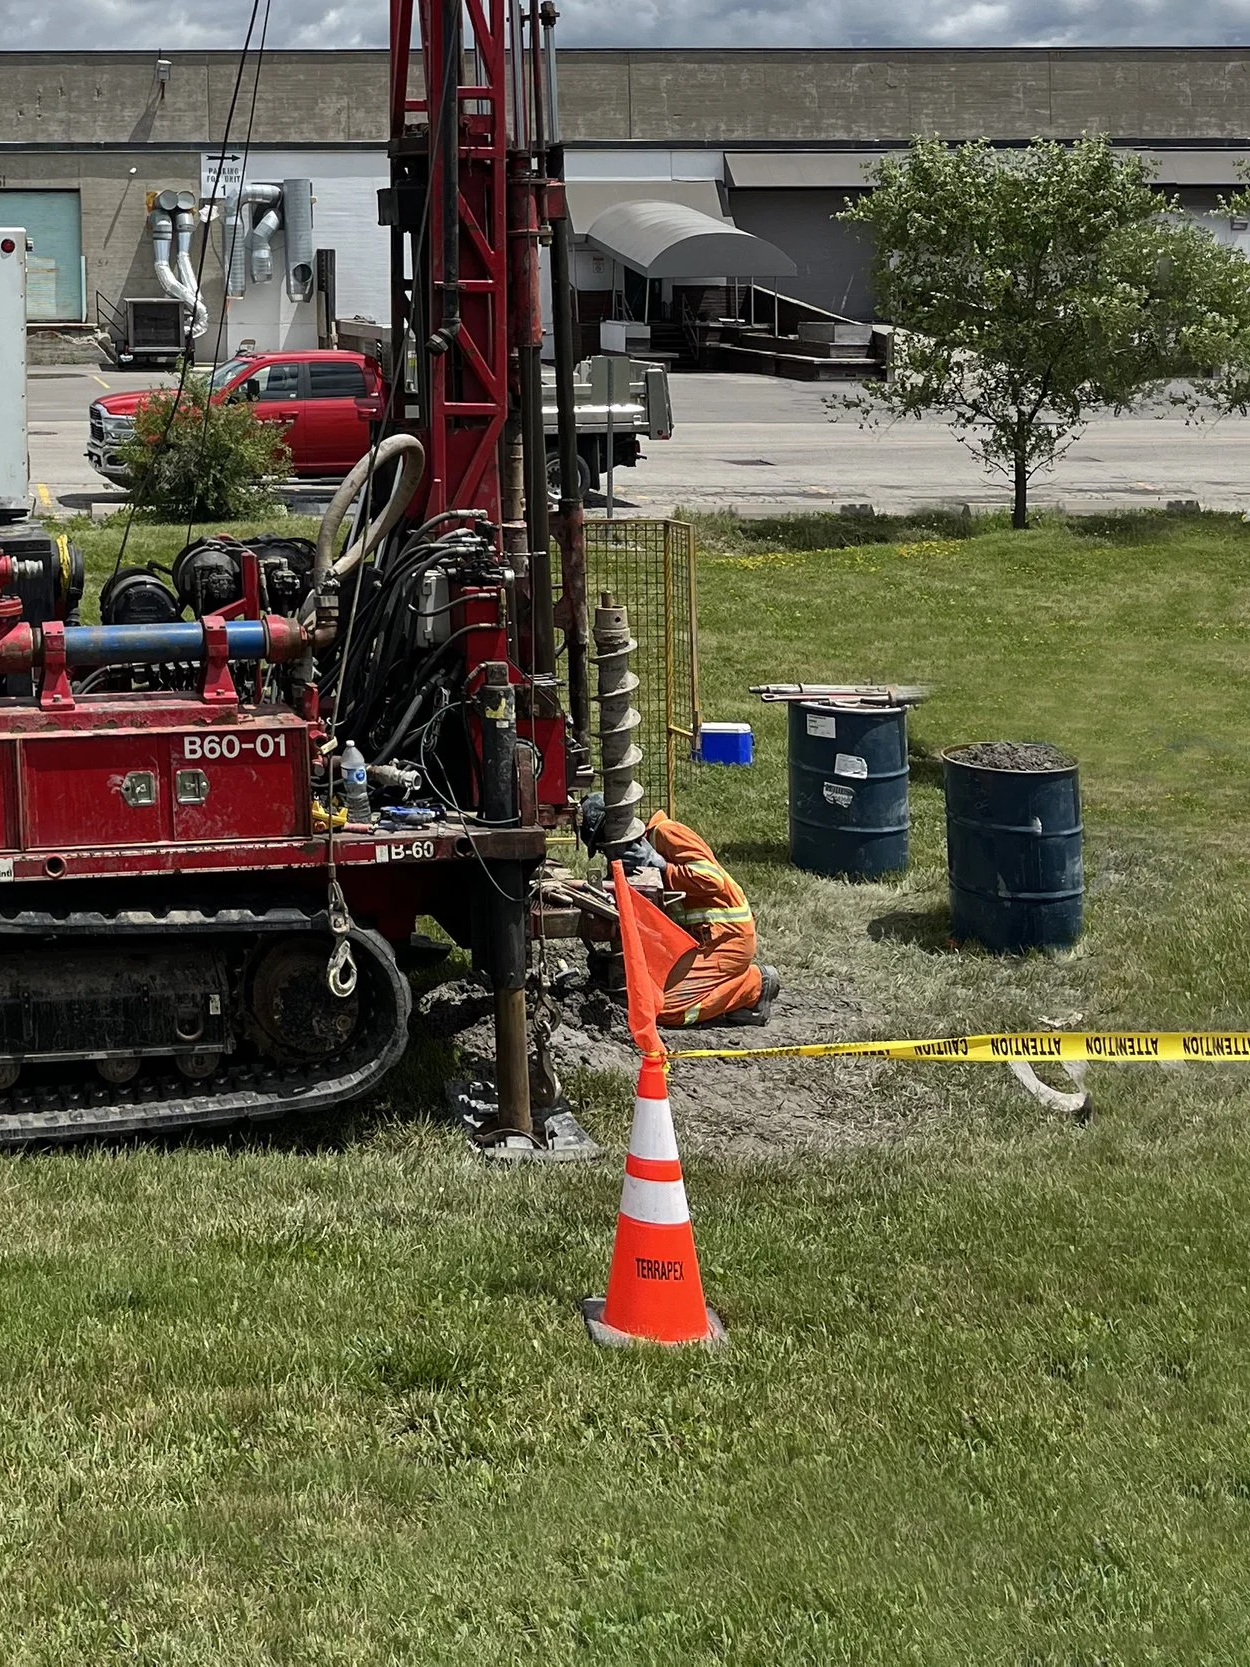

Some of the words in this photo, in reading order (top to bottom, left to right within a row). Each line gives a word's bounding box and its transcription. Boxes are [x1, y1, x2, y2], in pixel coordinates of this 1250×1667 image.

[207, 175, 220, 183] FO
[224, 175, 241, 183] UNIT
[208, 167, 239, 175] PAKING
[221, 184, 226, 196] 1
[183, 733, 286, 759] B60-01
[391, 840, 434, 859] B-60
[991, 1037, 1061, 1056] ATTENTION
[635, 1257, 685, 1280] TERRAPEX
